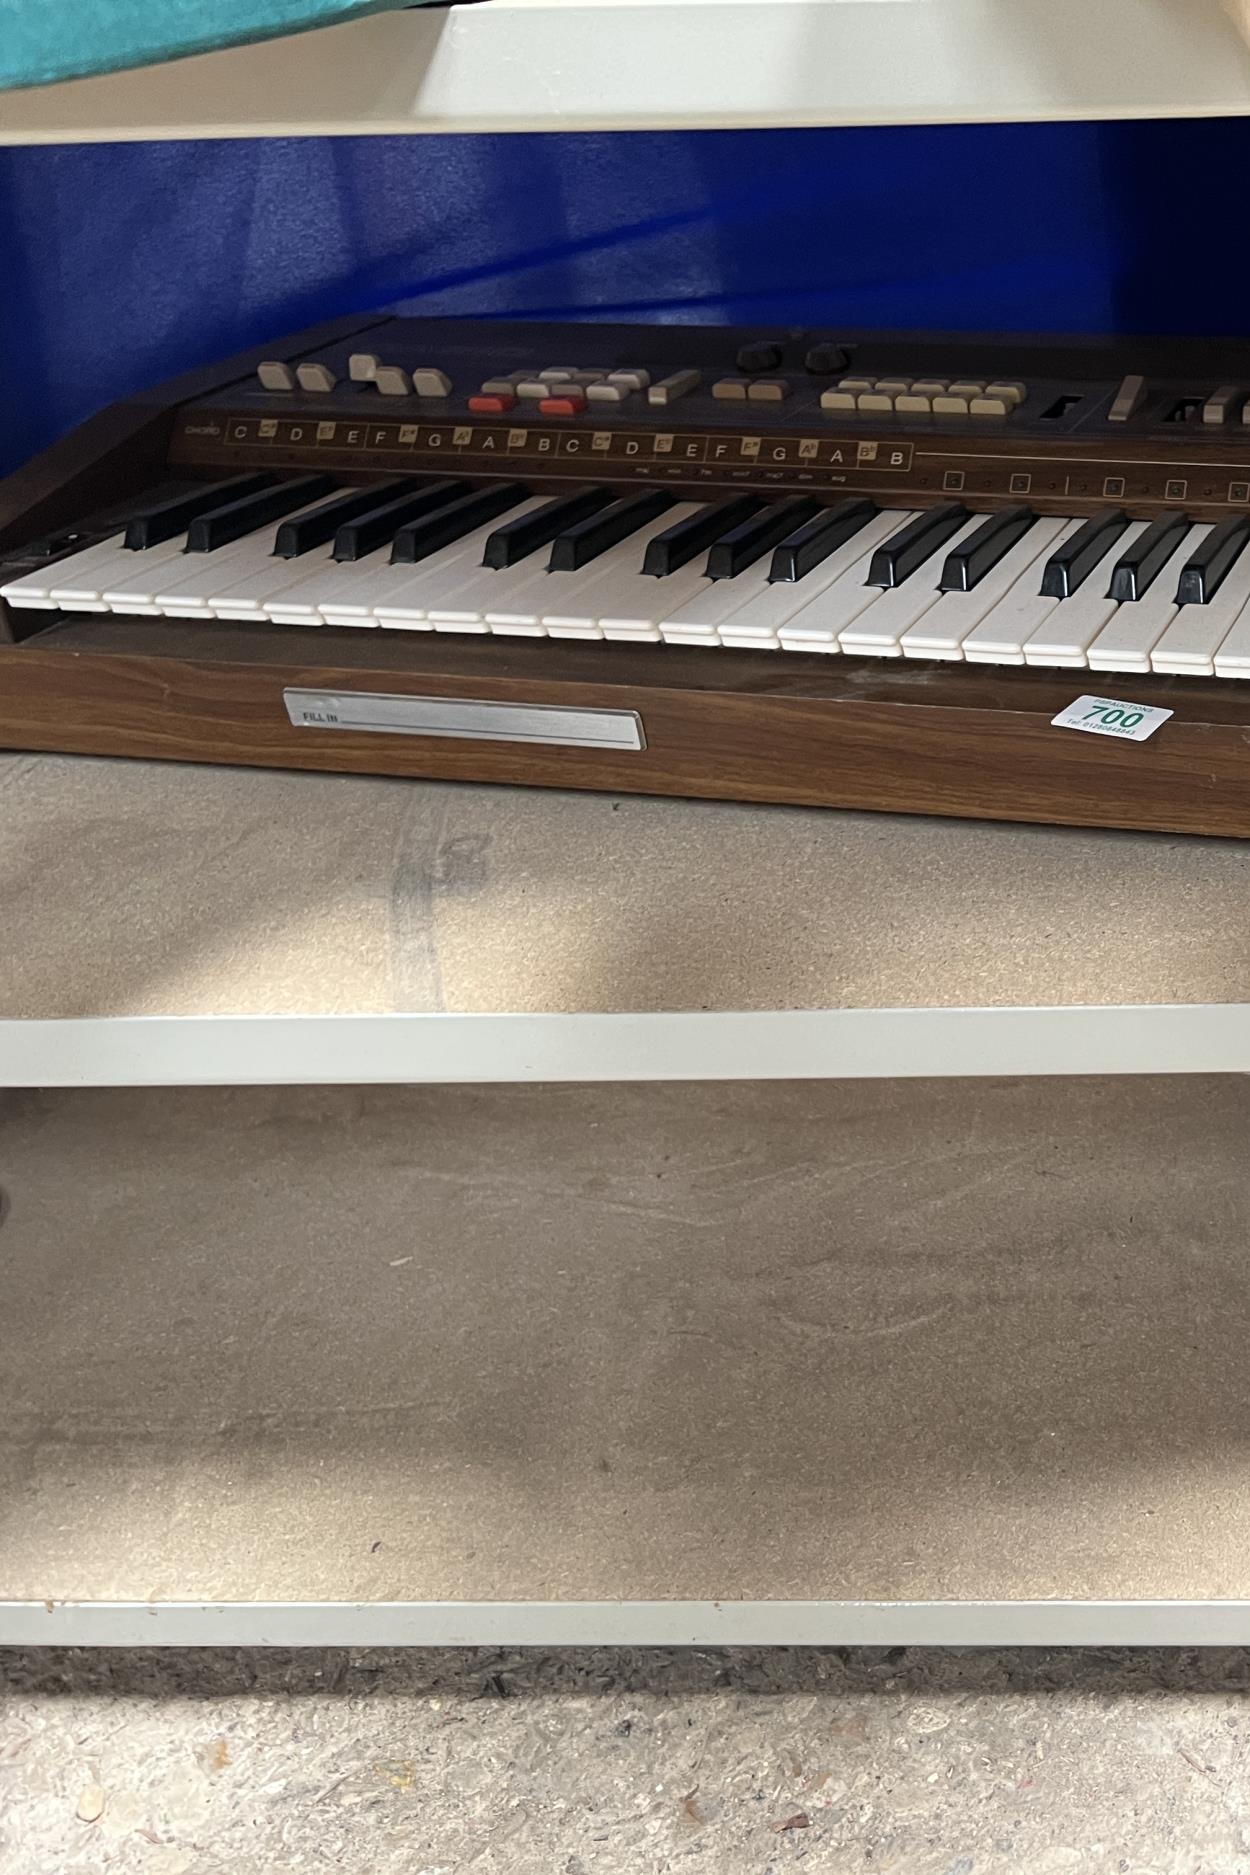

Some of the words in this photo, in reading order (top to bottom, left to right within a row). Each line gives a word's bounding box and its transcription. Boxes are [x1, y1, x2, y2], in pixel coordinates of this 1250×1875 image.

[234, 426, 248, 439] C
[290, 427, 303, 441] D
[347, 430, 360, 443] E
[375, 431, 386, 444] F
[428, 434, 441, 447] G
[482, 436, 495, 449] A
[538, 438, 550, 451] B
[566, 439, 580, 453] C
[626, 441, 639, 454] D
[686, 443, 699, 457] E
[715, 445, 728, 458] F
[772, 447, 787, 460] G
[830, 449, 844, 463] A
[890, 451, 904, 465] B
[303, 712, 325, 722] FILL
[326, 714, 338, 722] IN
[1081, 705, 1145, 728] 700
